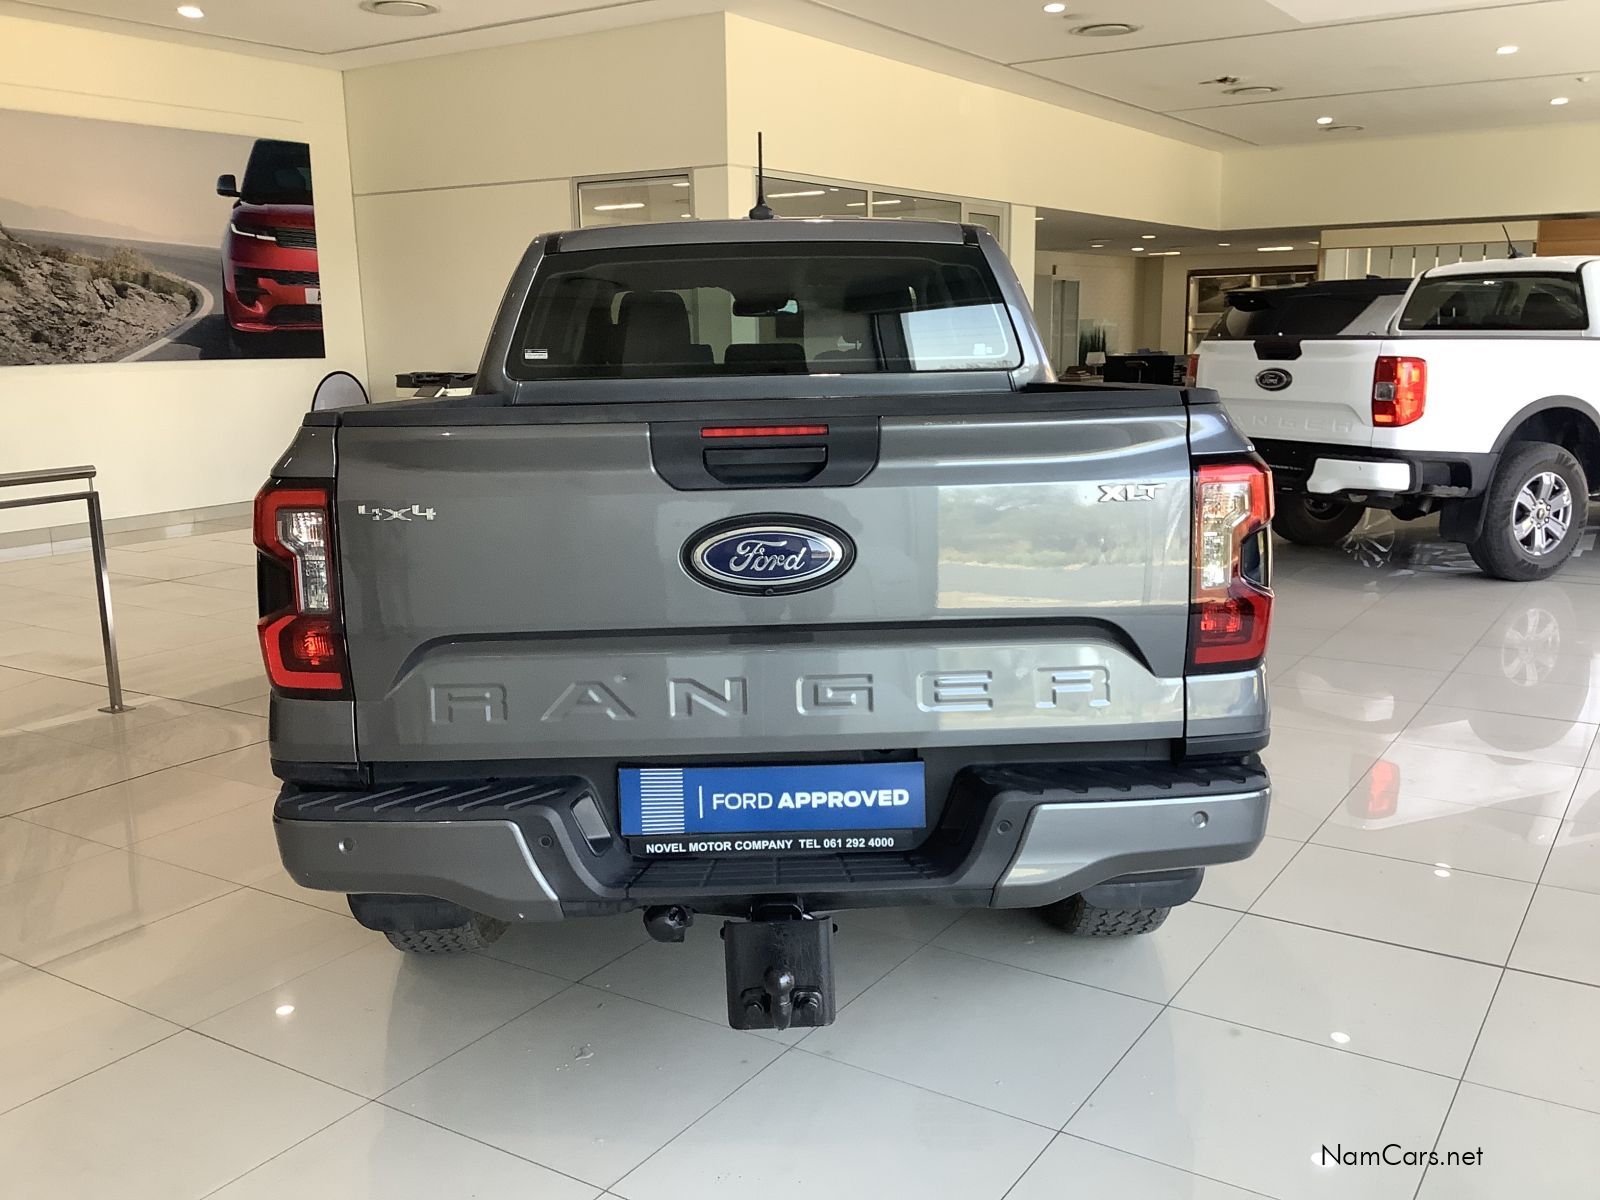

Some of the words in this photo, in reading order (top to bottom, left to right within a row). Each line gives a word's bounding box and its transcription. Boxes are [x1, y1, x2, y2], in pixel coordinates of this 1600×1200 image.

[1098, 482, 1168, 502] XLT
[729, 539, 806, 572] Ford
[429, 665, 1111, 724] RANGER
[712, 792, 773, 810] FORD
[777, 788, 910, 809] APPROVED
[646, 843, 687, 853] NOVEL
[688, 841, 732, 852] MOTOR
[734, 839, 793, 851] COMPANY
[799, 839, 821, 849] TEL
[823, 838, 842, 848] 061
[846, 837, 866, 848] 292
[868, 837, 894, 847] 4000
